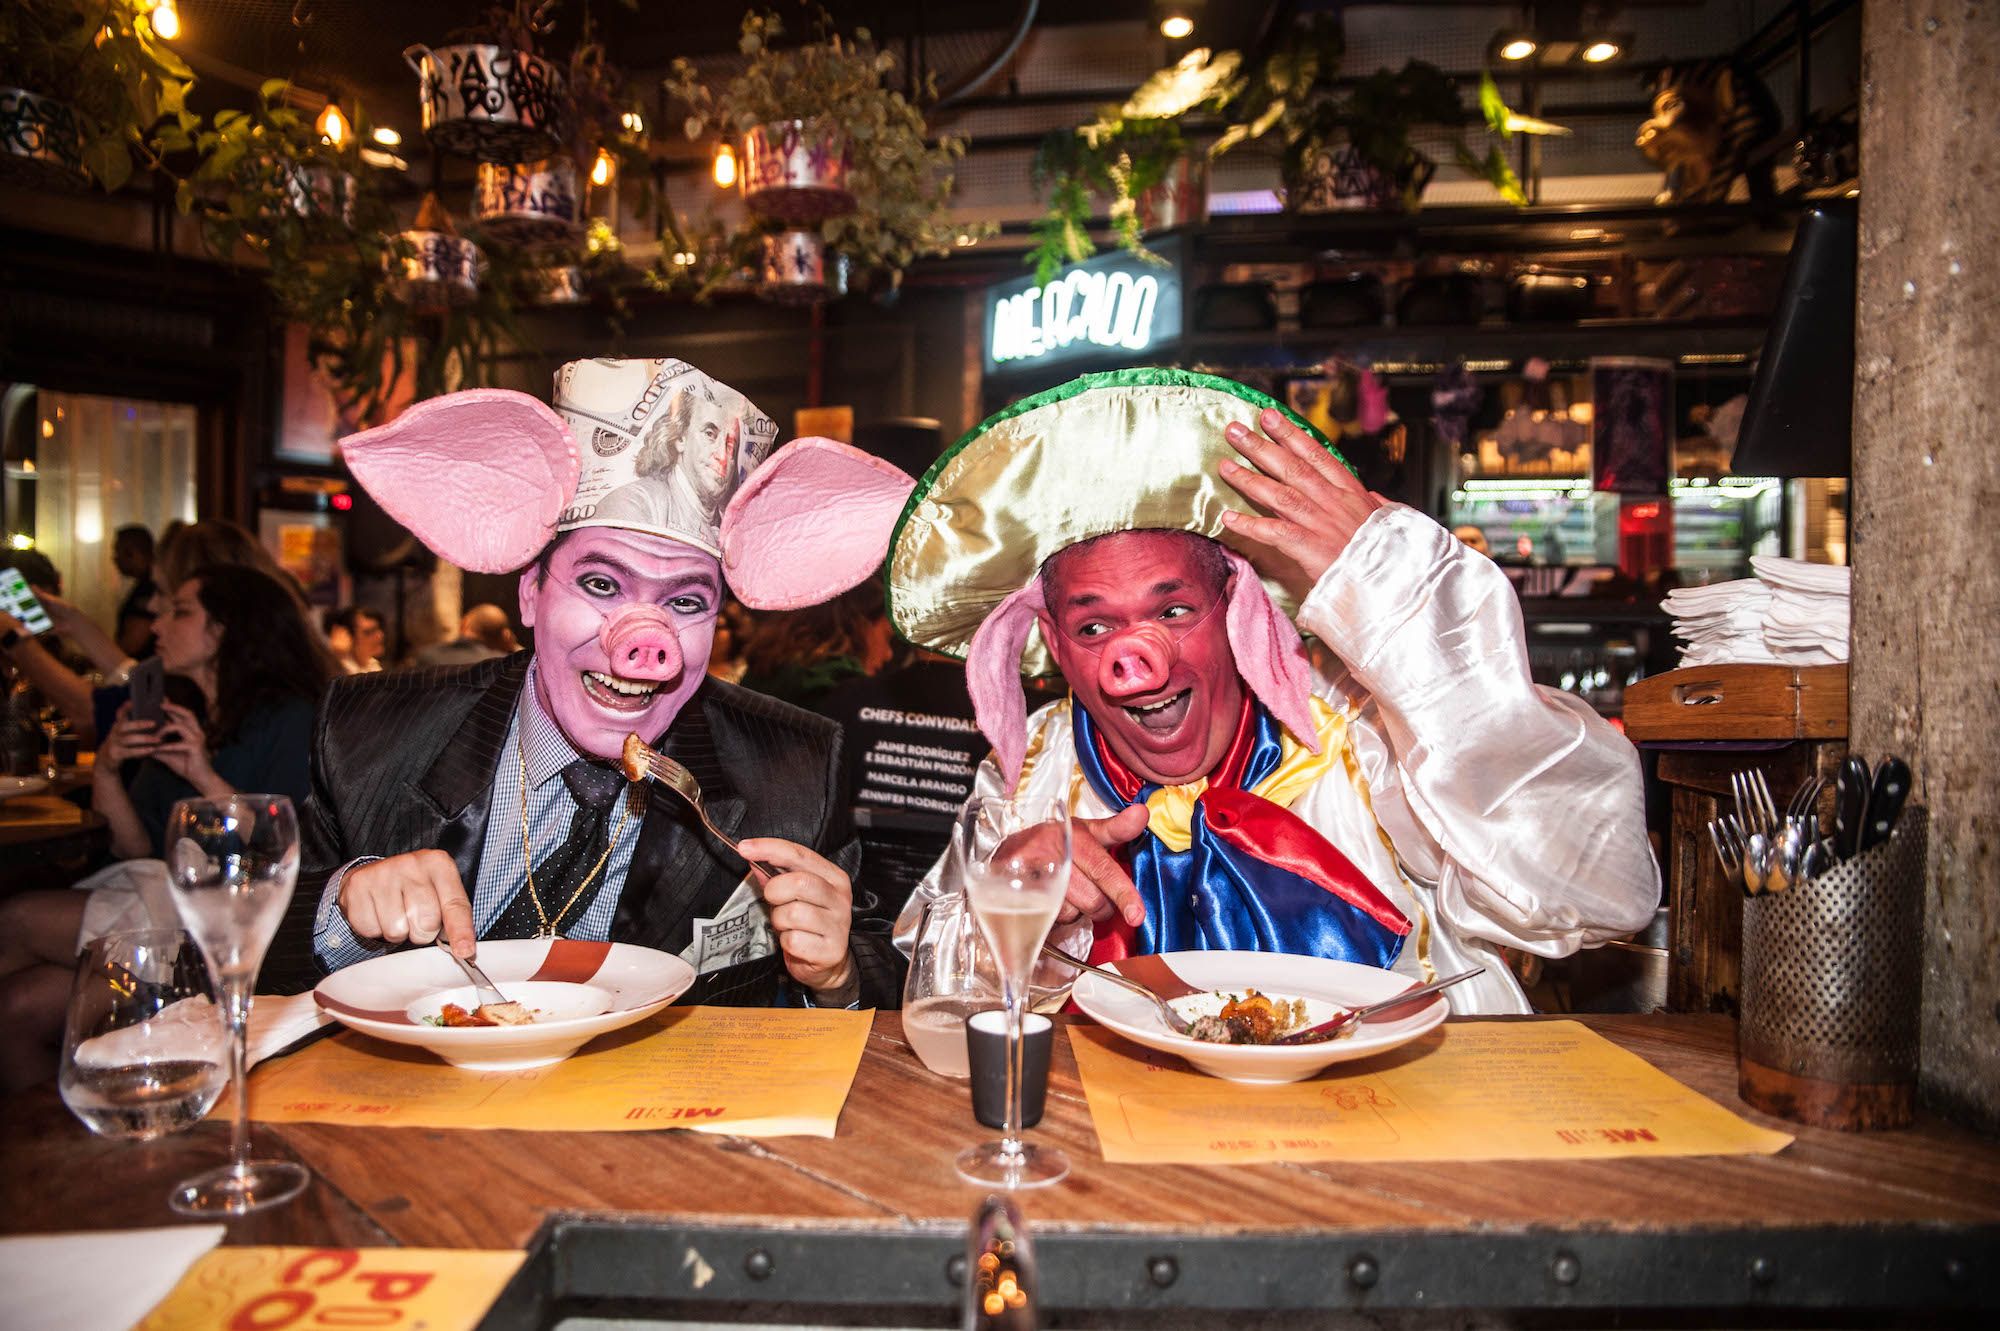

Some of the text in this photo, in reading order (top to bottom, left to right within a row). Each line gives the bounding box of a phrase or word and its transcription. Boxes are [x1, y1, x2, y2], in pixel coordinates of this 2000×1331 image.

[859, 707, 904, 724] CHEFS
[865, 752, 873, 762] E
[874, 753, 932, 770] SEBASTIÁN
[866, 771, 967, 795] MARCELA ARANGO
[859, 789, 905, 804] JENNIFER
